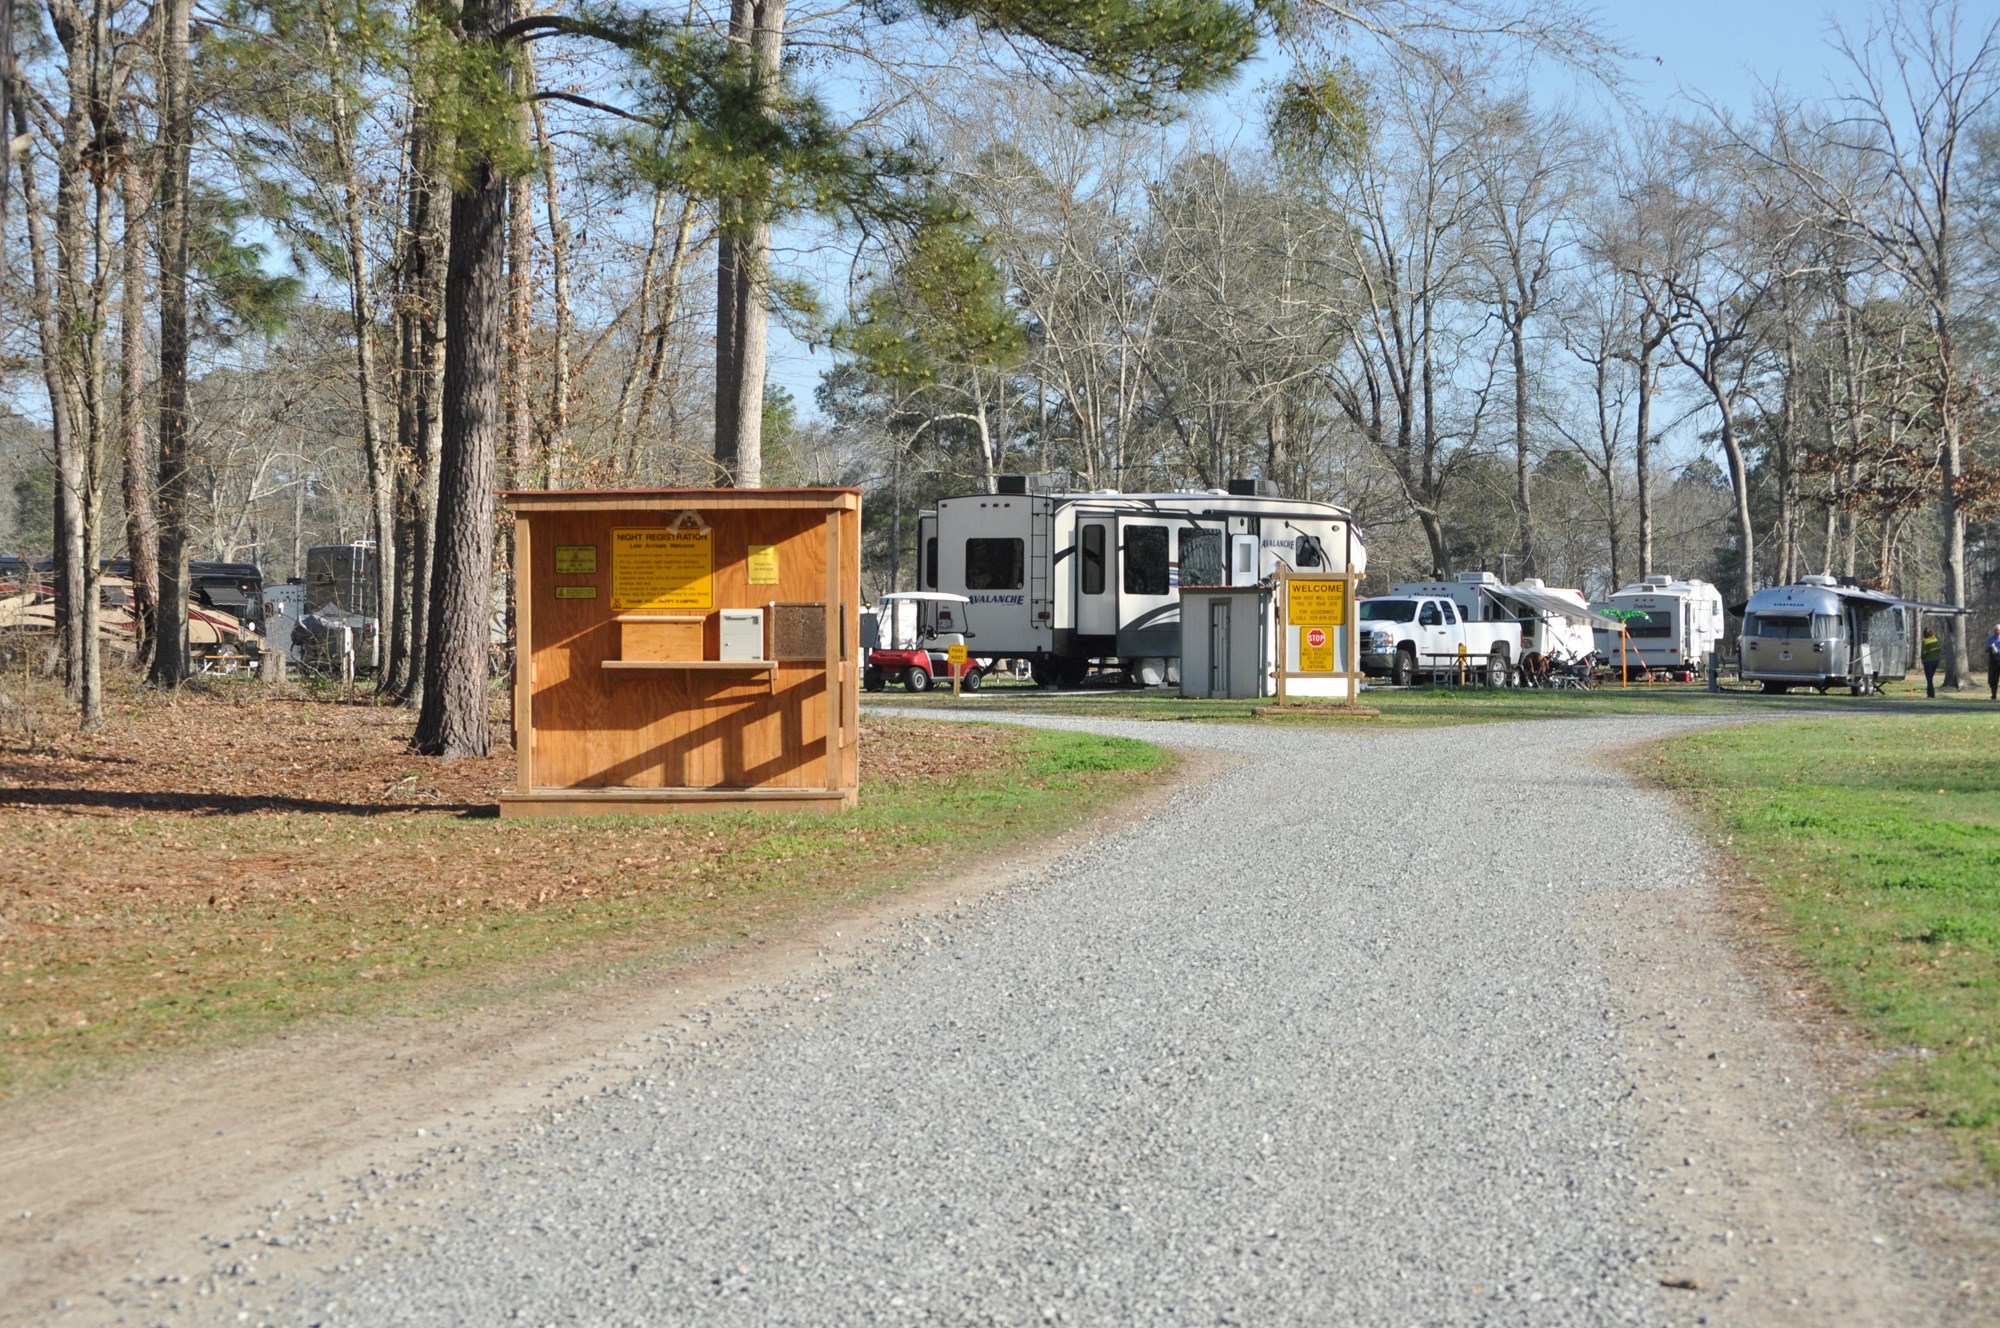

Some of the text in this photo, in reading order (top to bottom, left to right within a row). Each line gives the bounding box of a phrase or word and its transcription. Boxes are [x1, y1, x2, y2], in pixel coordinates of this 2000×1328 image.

[617, 533, 707, 541] NIGHT REGISTRATION
[1261, 539, 1295, 549] AVALANCHE
[1292, 584, 1342, 593] WELCOME
[966, 595, 1024, 605] AVALANCHE
[1308, 634, 1325, 642] STOP
